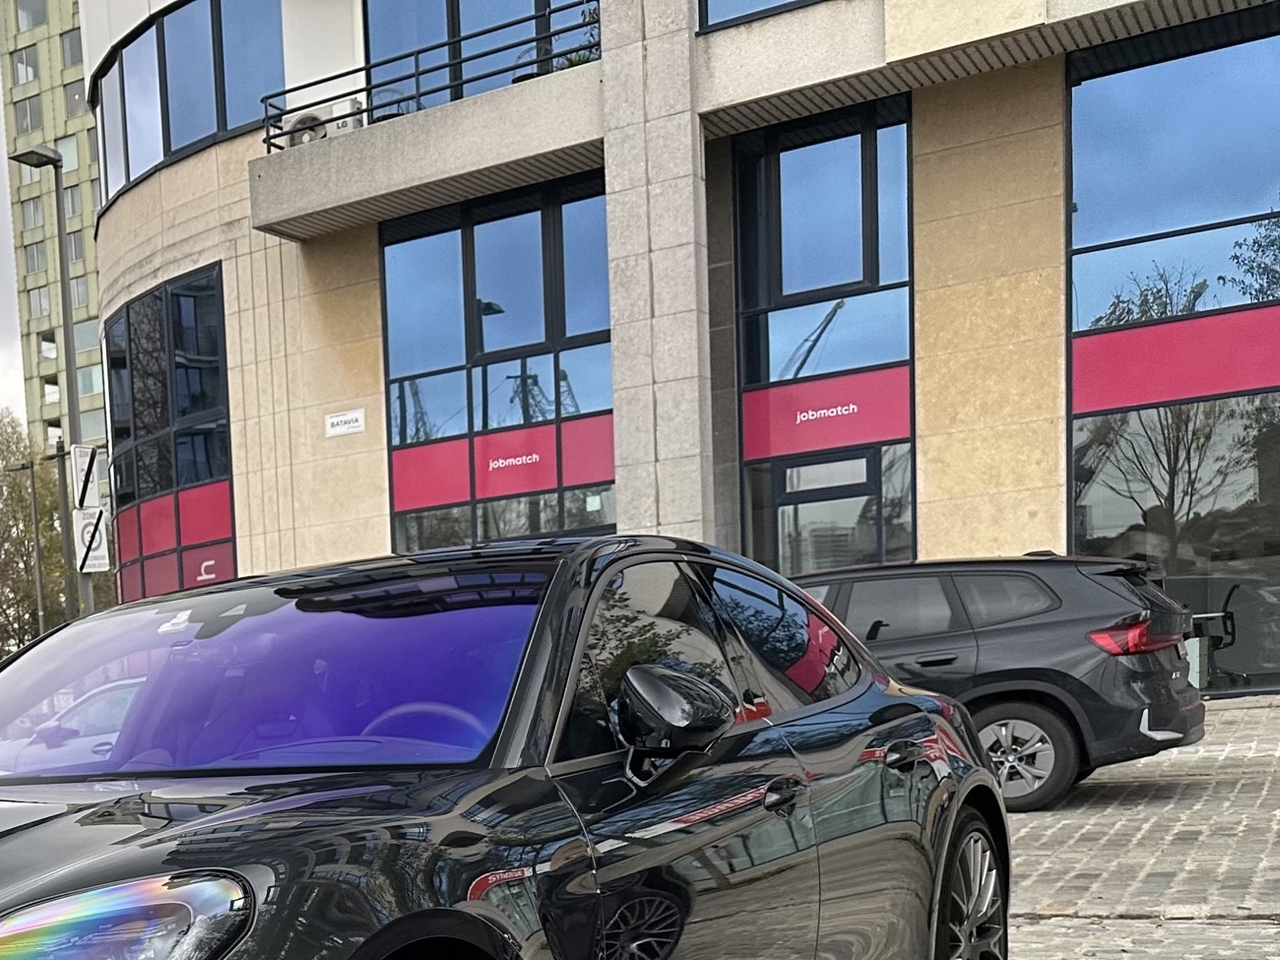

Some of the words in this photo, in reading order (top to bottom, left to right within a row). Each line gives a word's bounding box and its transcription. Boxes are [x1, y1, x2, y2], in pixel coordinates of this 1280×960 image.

[336, 121, 348, 130] LG
[795, 403, 858, 424] jobmatch
[330, 417, 359, 429] BATAVIA
[488, 453, 540, 472] jobmatch
